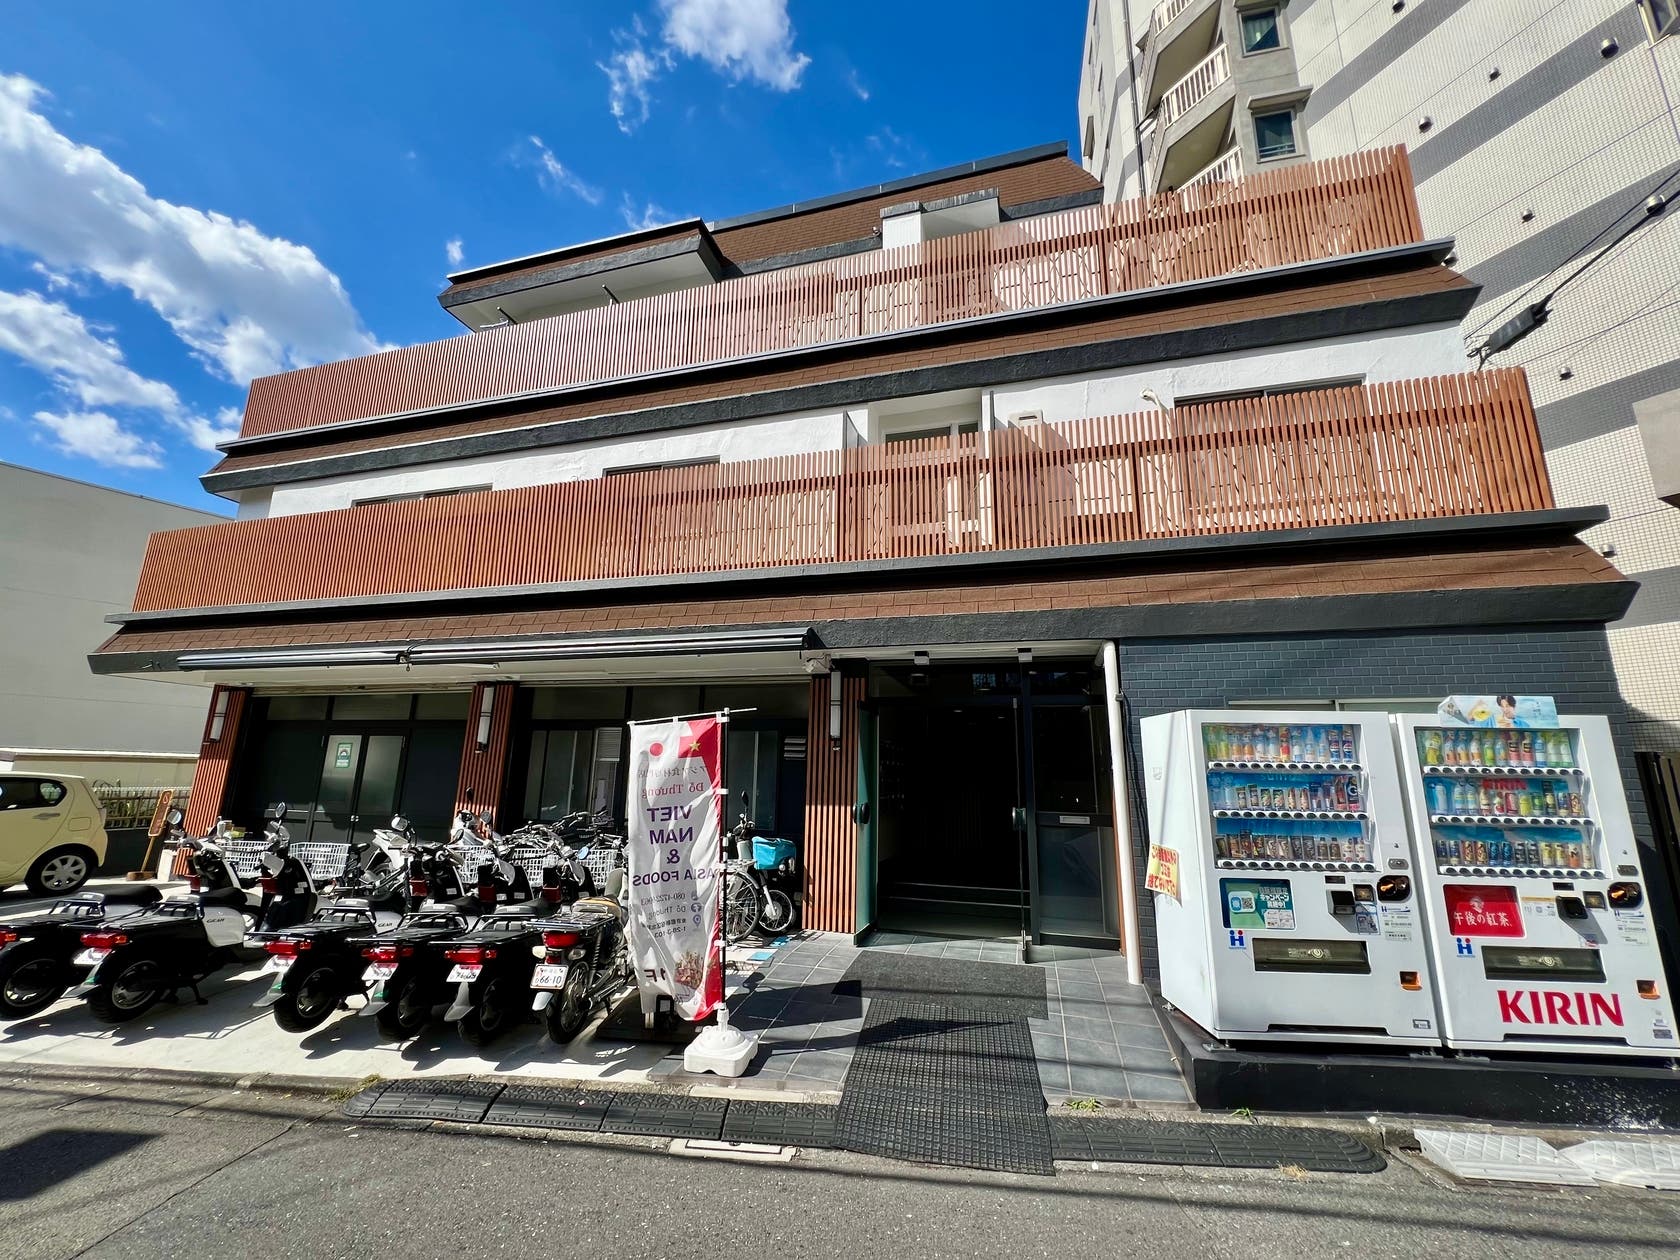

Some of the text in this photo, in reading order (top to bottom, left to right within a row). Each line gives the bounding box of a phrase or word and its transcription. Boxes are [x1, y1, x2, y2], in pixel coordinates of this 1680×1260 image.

[1453, 911, 1510, 927] 午後の紅茶
[1496, 989, 1625, 1027] KIRIN
